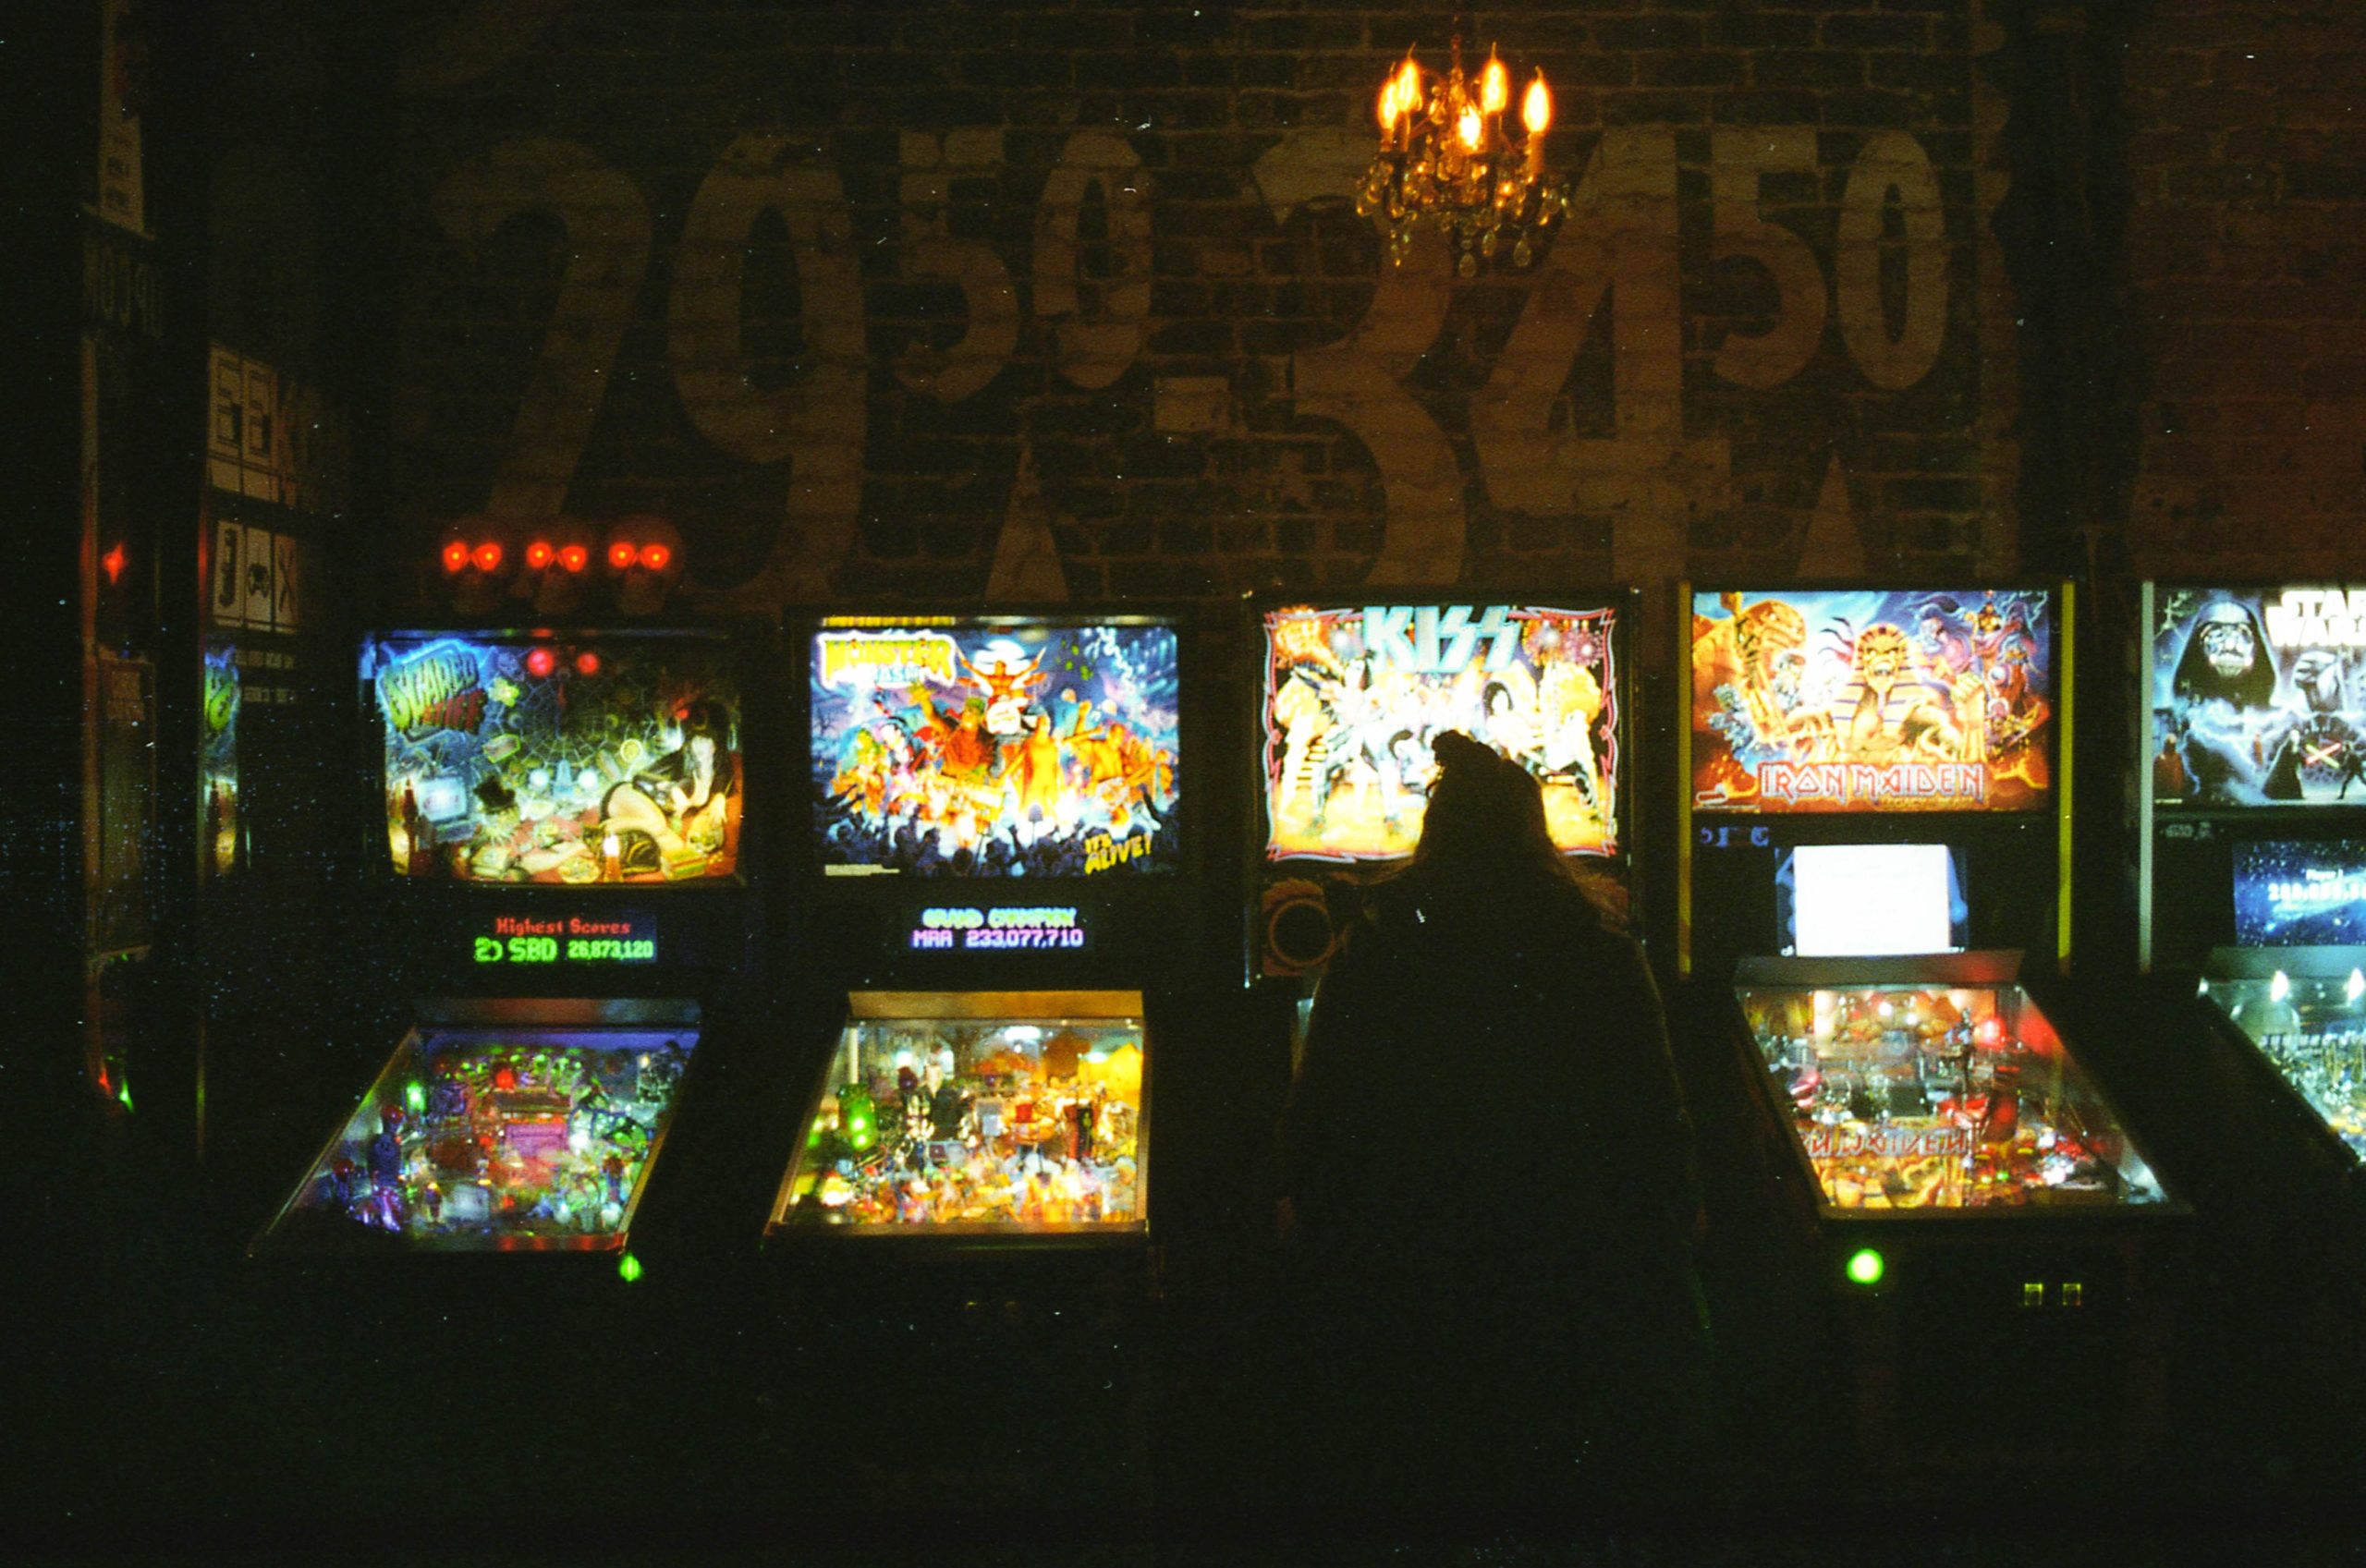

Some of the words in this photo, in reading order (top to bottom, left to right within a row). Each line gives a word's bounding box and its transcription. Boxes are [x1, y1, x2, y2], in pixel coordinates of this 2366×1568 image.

[1363, 605, 1521, 674] KISS
[1759, 763, 1846, 805] IRON
[1850, 763, 1984, 805] MAIDEN
[1084, 833, 1152, 875] ALIVE!
[495, 917, 563, 937] Highest
[568, 917, 631, 935] Scores
[965, 929, 1084, 949] 233,077,710
